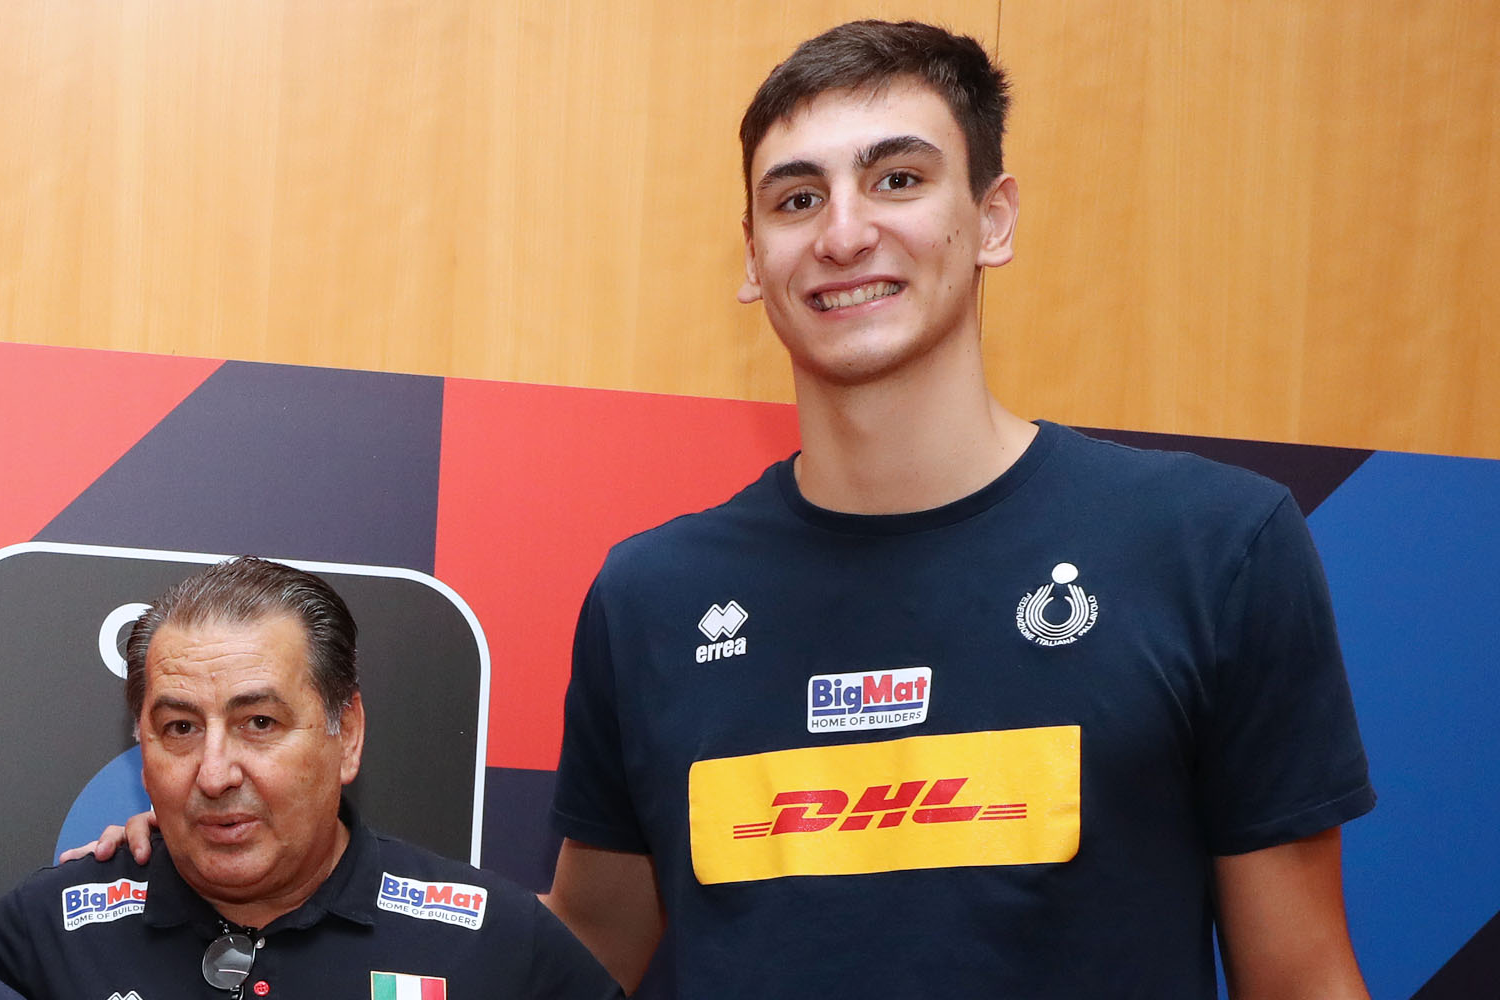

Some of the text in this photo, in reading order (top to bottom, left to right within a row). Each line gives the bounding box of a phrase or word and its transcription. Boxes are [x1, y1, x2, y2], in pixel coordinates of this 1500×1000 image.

[1035, 635, 1078, 647] ITALIANA
[812, 674, 927, 715] BigMat
[811, 711, 923, 728] HOME OF BUILDERS
[770, 777, 983, 836] DHL
[65, 881, 148, 913] BigMa
[382, 876, 484, 911] BigMat
[67, 904, 146, 928] HOME OF BUILDE
[378, 899, 477, 927] HOME OF BUILDERS
